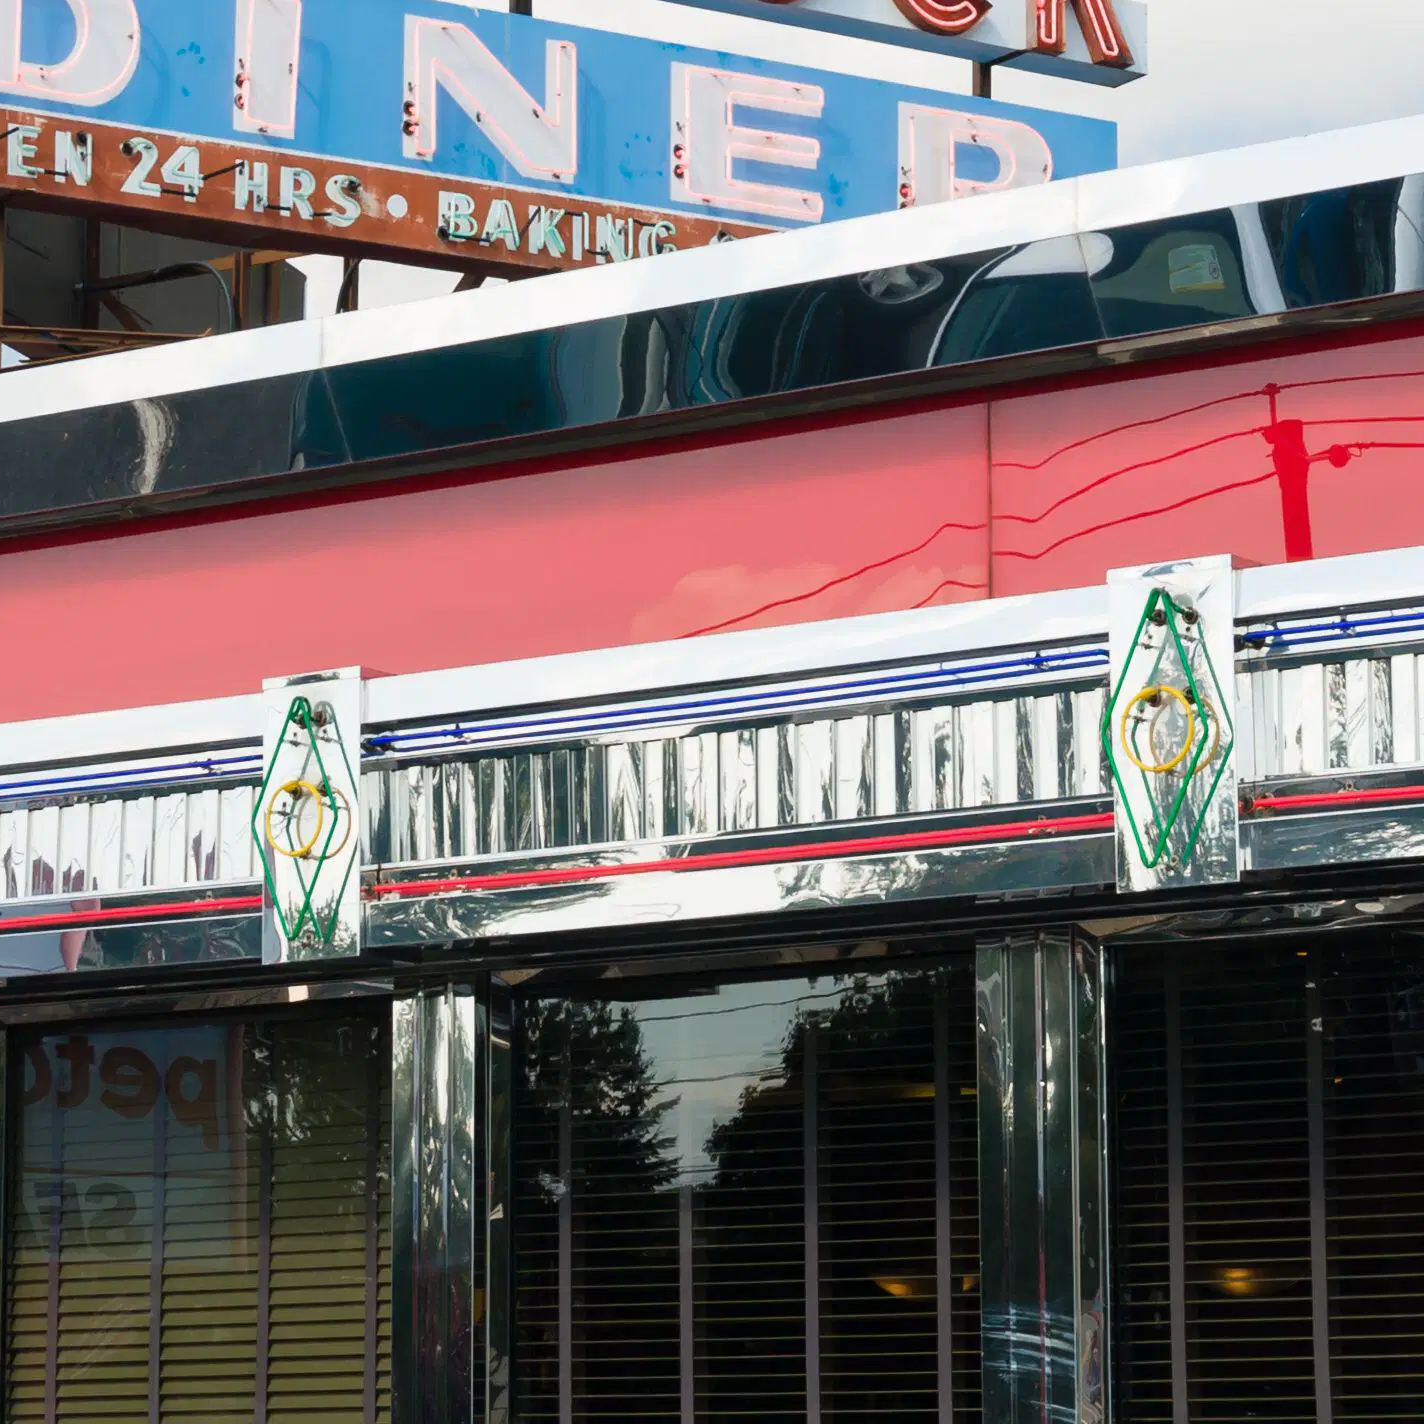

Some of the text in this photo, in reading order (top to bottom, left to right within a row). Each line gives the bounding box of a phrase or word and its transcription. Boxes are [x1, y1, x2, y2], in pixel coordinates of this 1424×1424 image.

[119, 135, 205, 204] 24
[234, 158, 362, 228] HRS
[437, 189, 677, 264] BAKING
